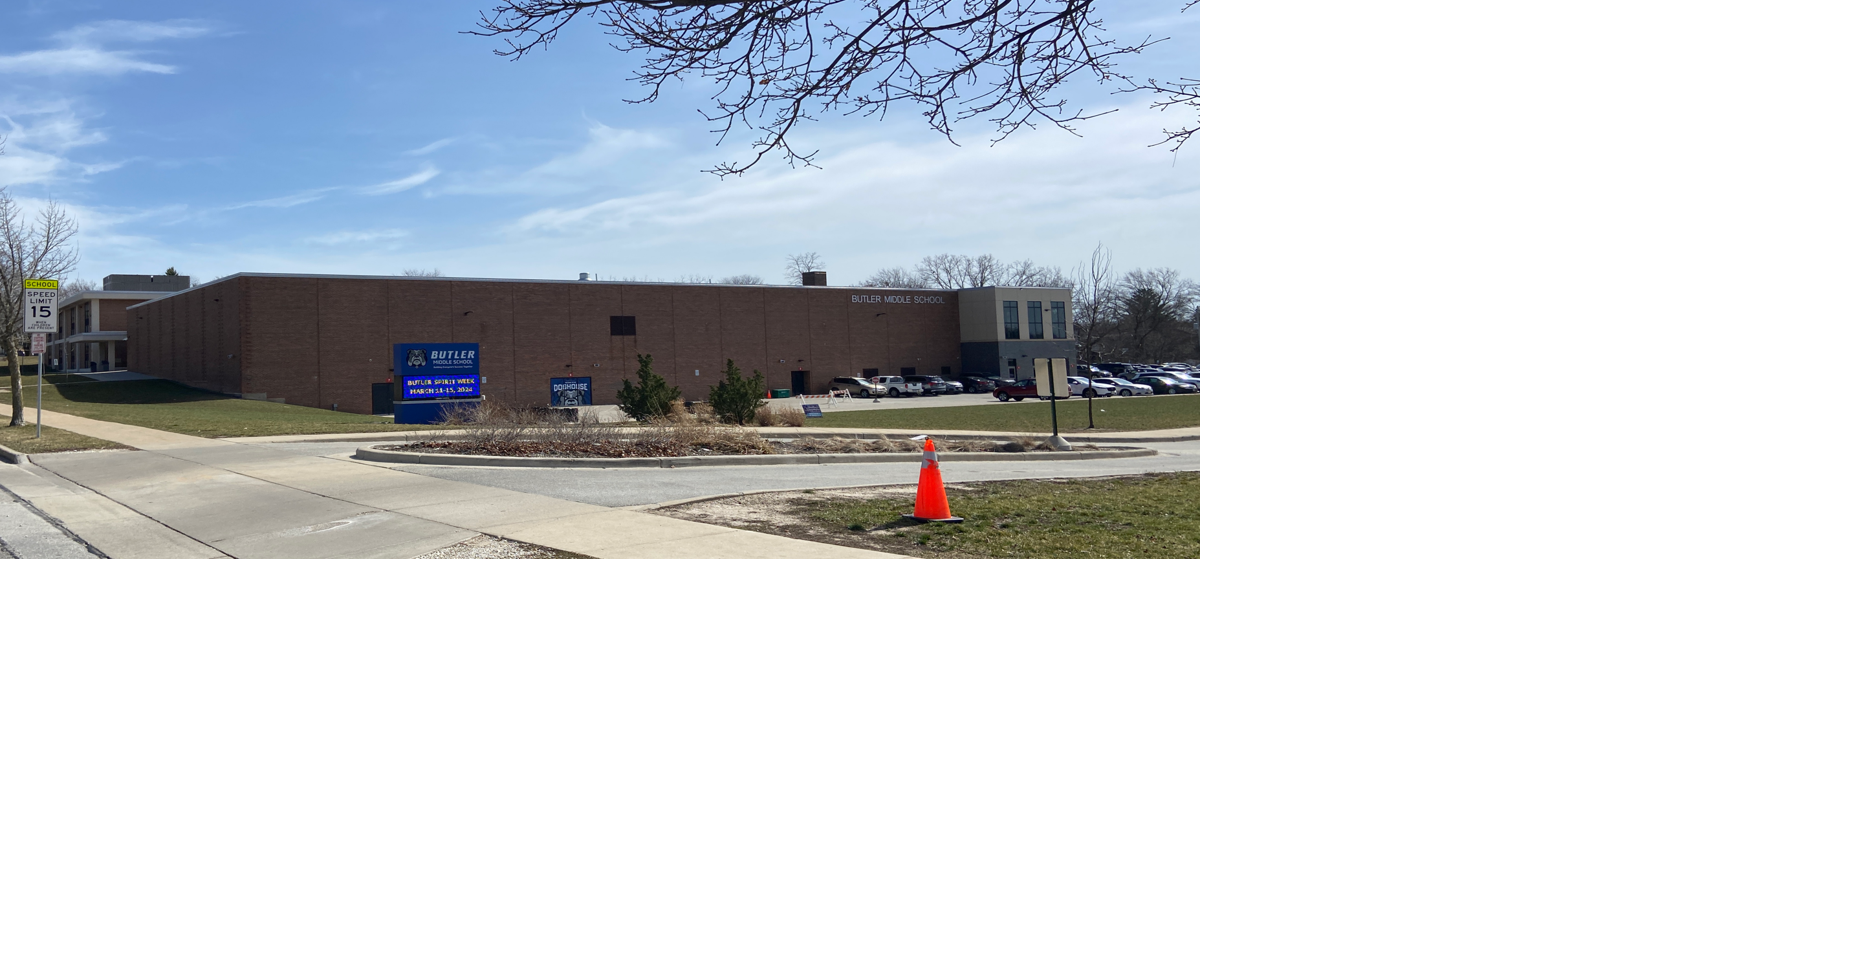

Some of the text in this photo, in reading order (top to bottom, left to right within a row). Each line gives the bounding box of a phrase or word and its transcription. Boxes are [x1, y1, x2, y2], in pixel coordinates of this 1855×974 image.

[852, 294, 945, 304] BUTLER MIDDLE SCHOOL
[31, 306, 51, 318] 15
[430, 350, 475, 359] BUTLER
